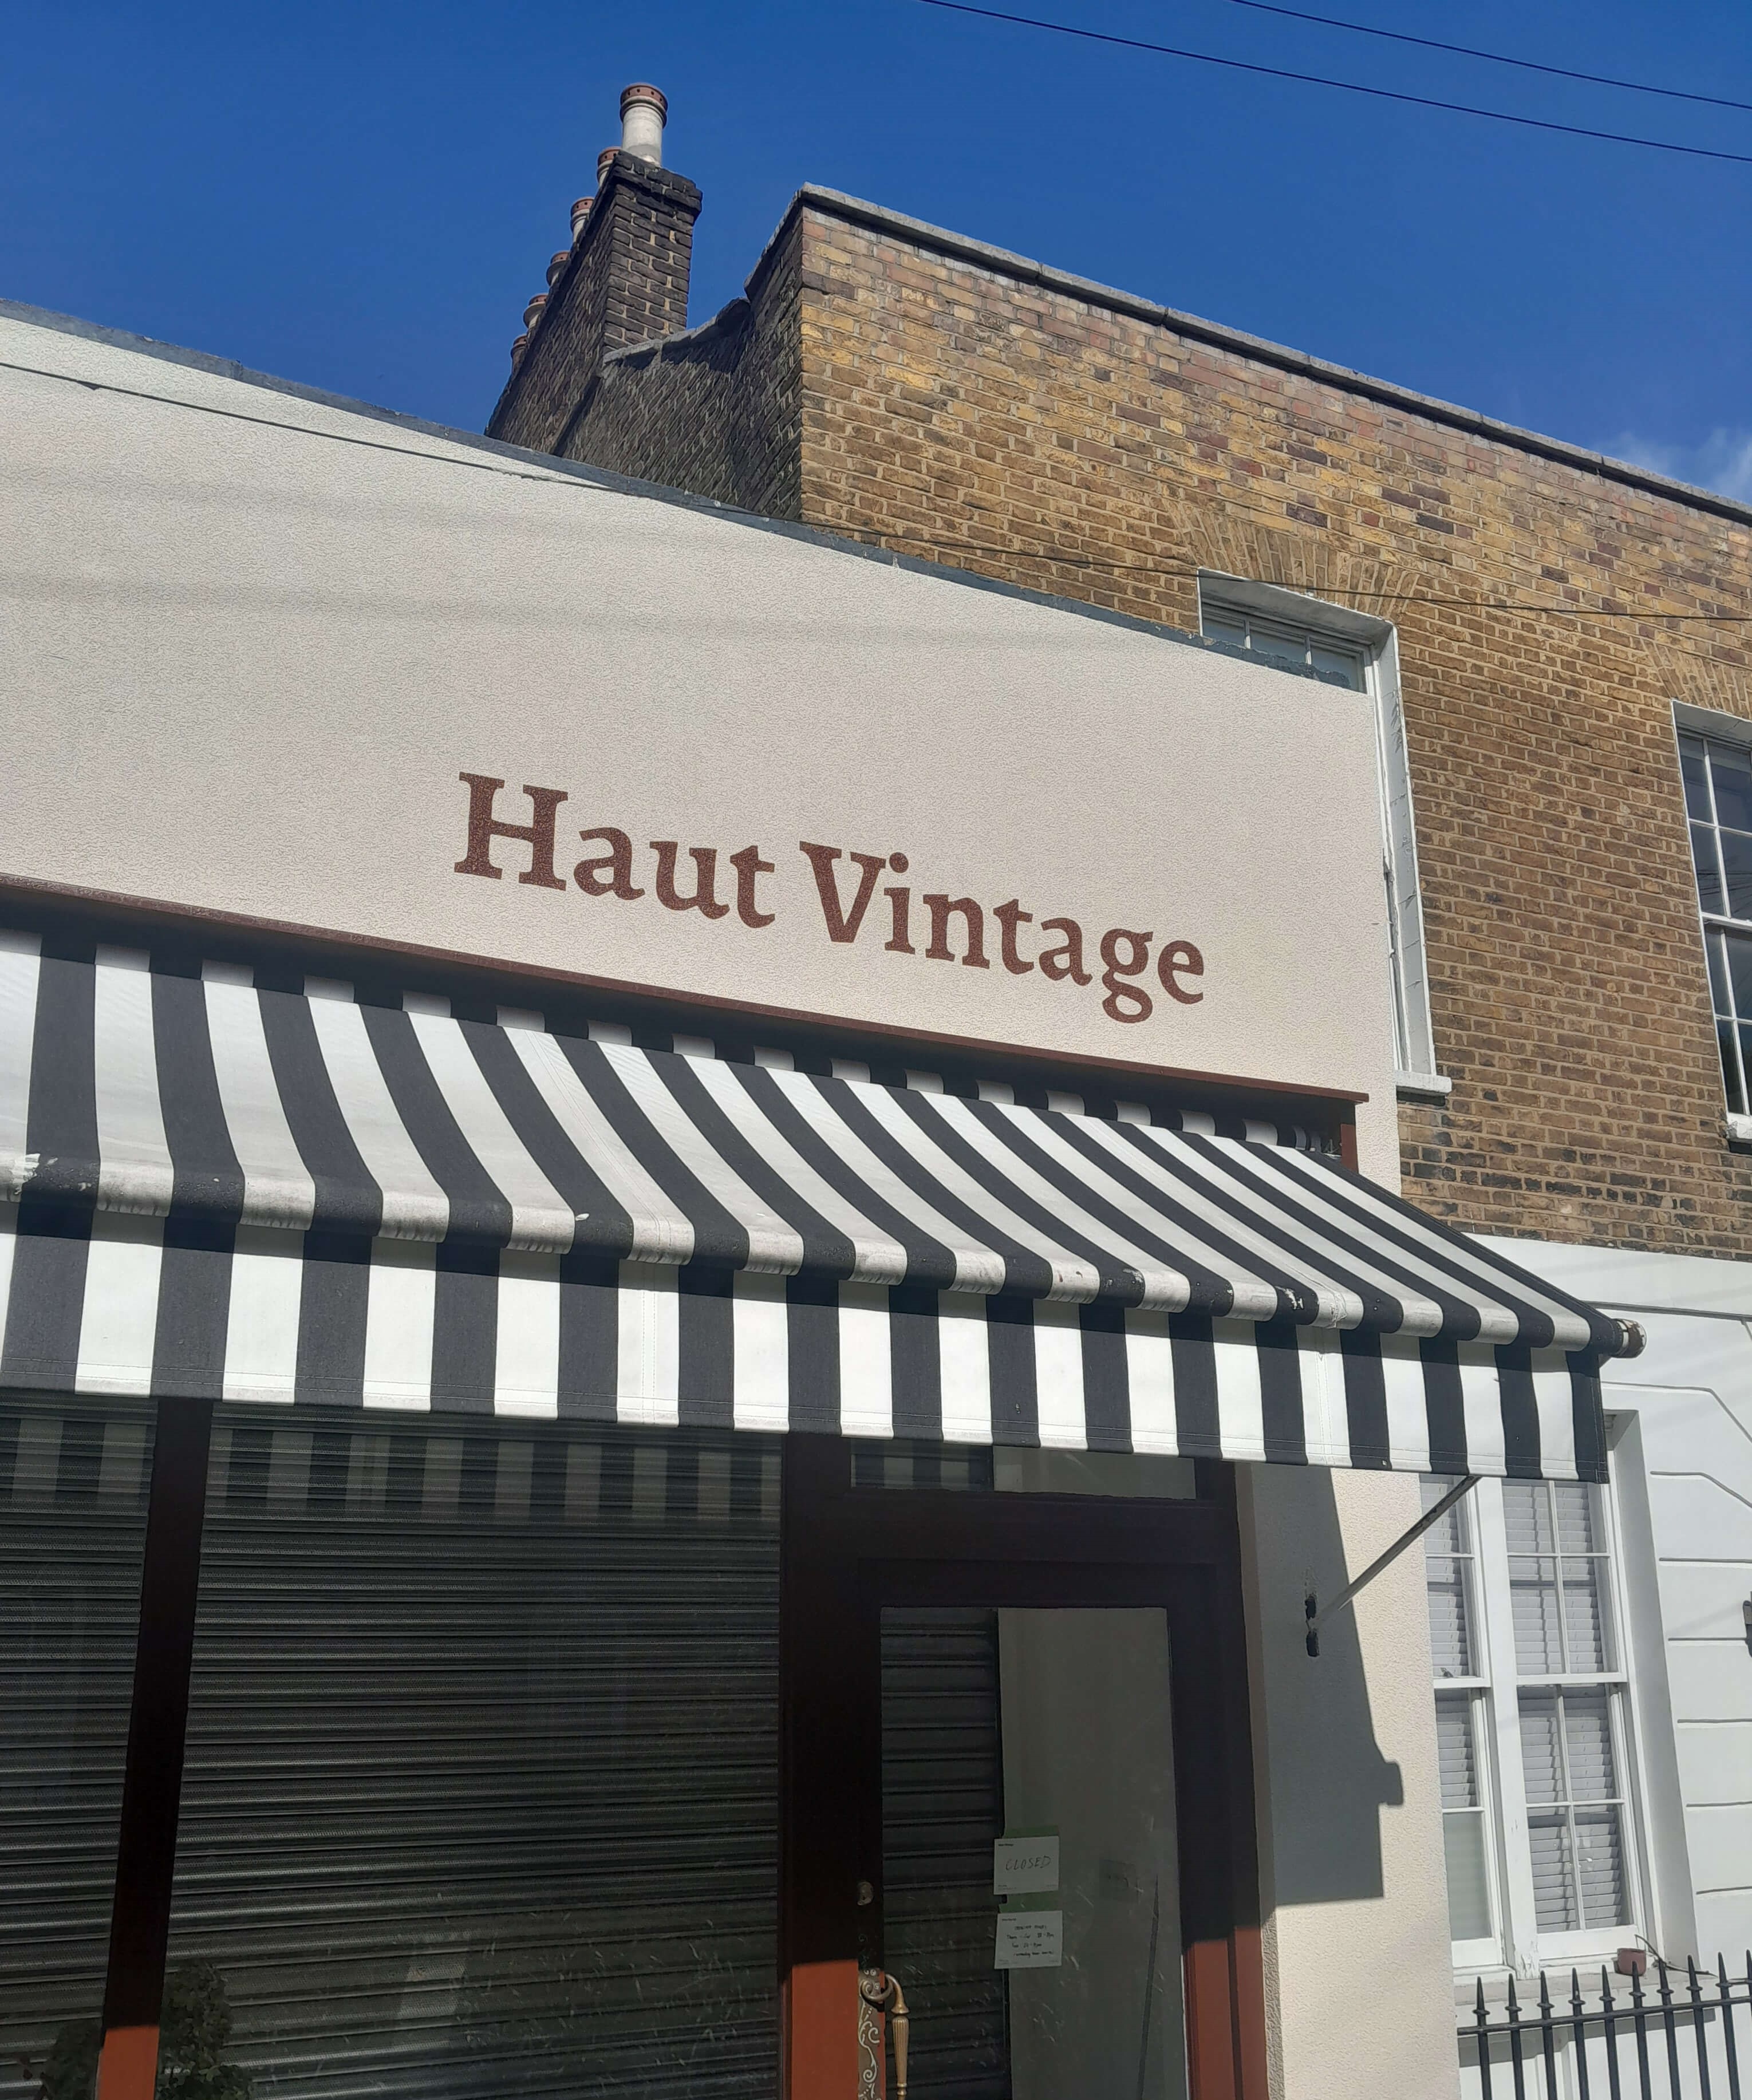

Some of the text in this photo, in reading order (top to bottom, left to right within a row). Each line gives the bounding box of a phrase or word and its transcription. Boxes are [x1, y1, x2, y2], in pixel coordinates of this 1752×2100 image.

[454, 772, 1205, 1024] Haut Vintage
[1005, 1855, 1051, 1870] CLOSED
